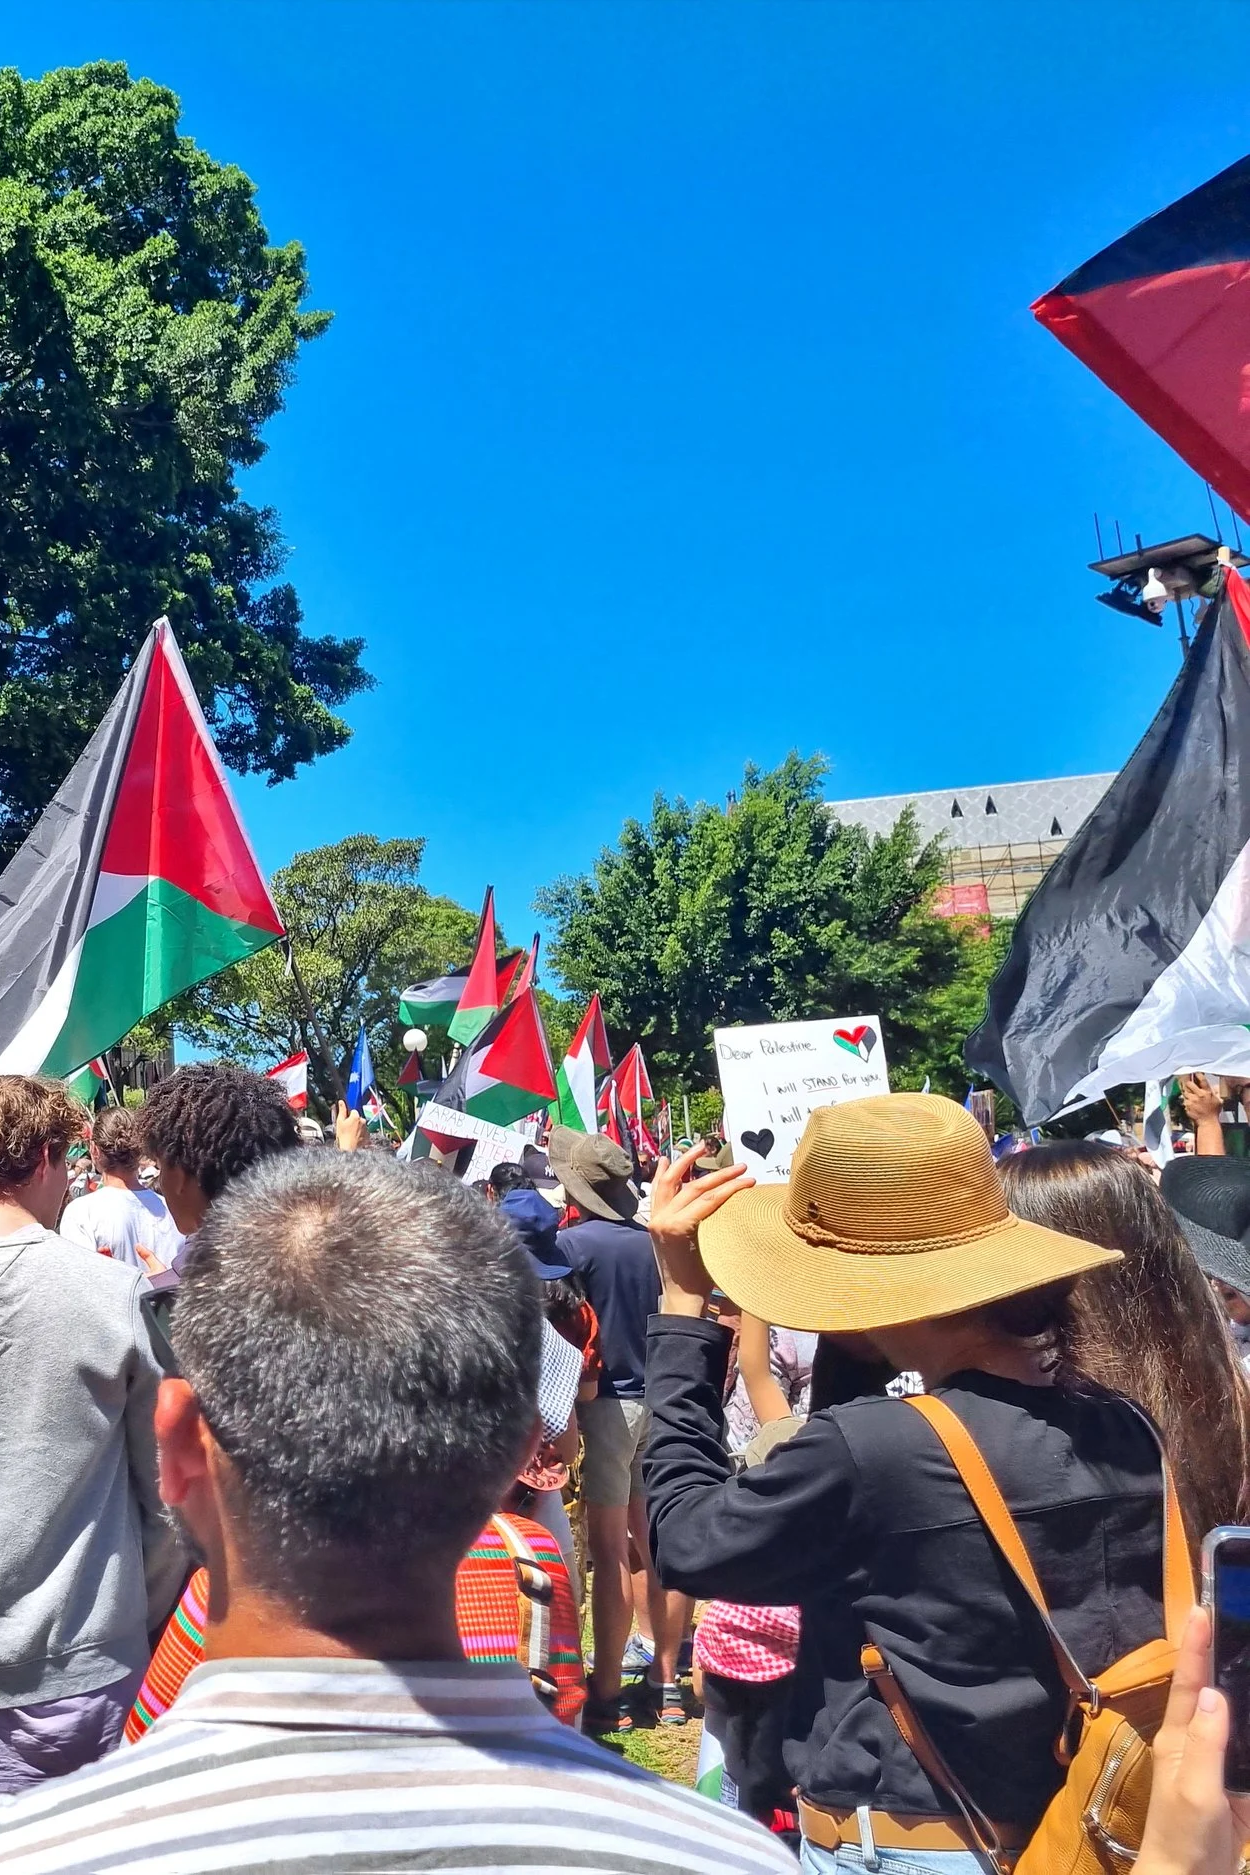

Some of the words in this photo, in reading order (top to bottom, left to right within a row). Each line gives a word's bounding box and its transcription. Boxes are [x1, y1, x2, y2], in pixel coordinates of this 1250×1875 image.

[719, 1043, 753, 1060] Dear
[777, 1082, 797, 1095] will
[802, 1075, 839, 1091] STAND
[842, 1074, 857, 1086] for
[429, 1105, 465, 1128] ARAB
[473, 1120, 508, 1144] LIVES
[781, 1107, 802, 1124] will
